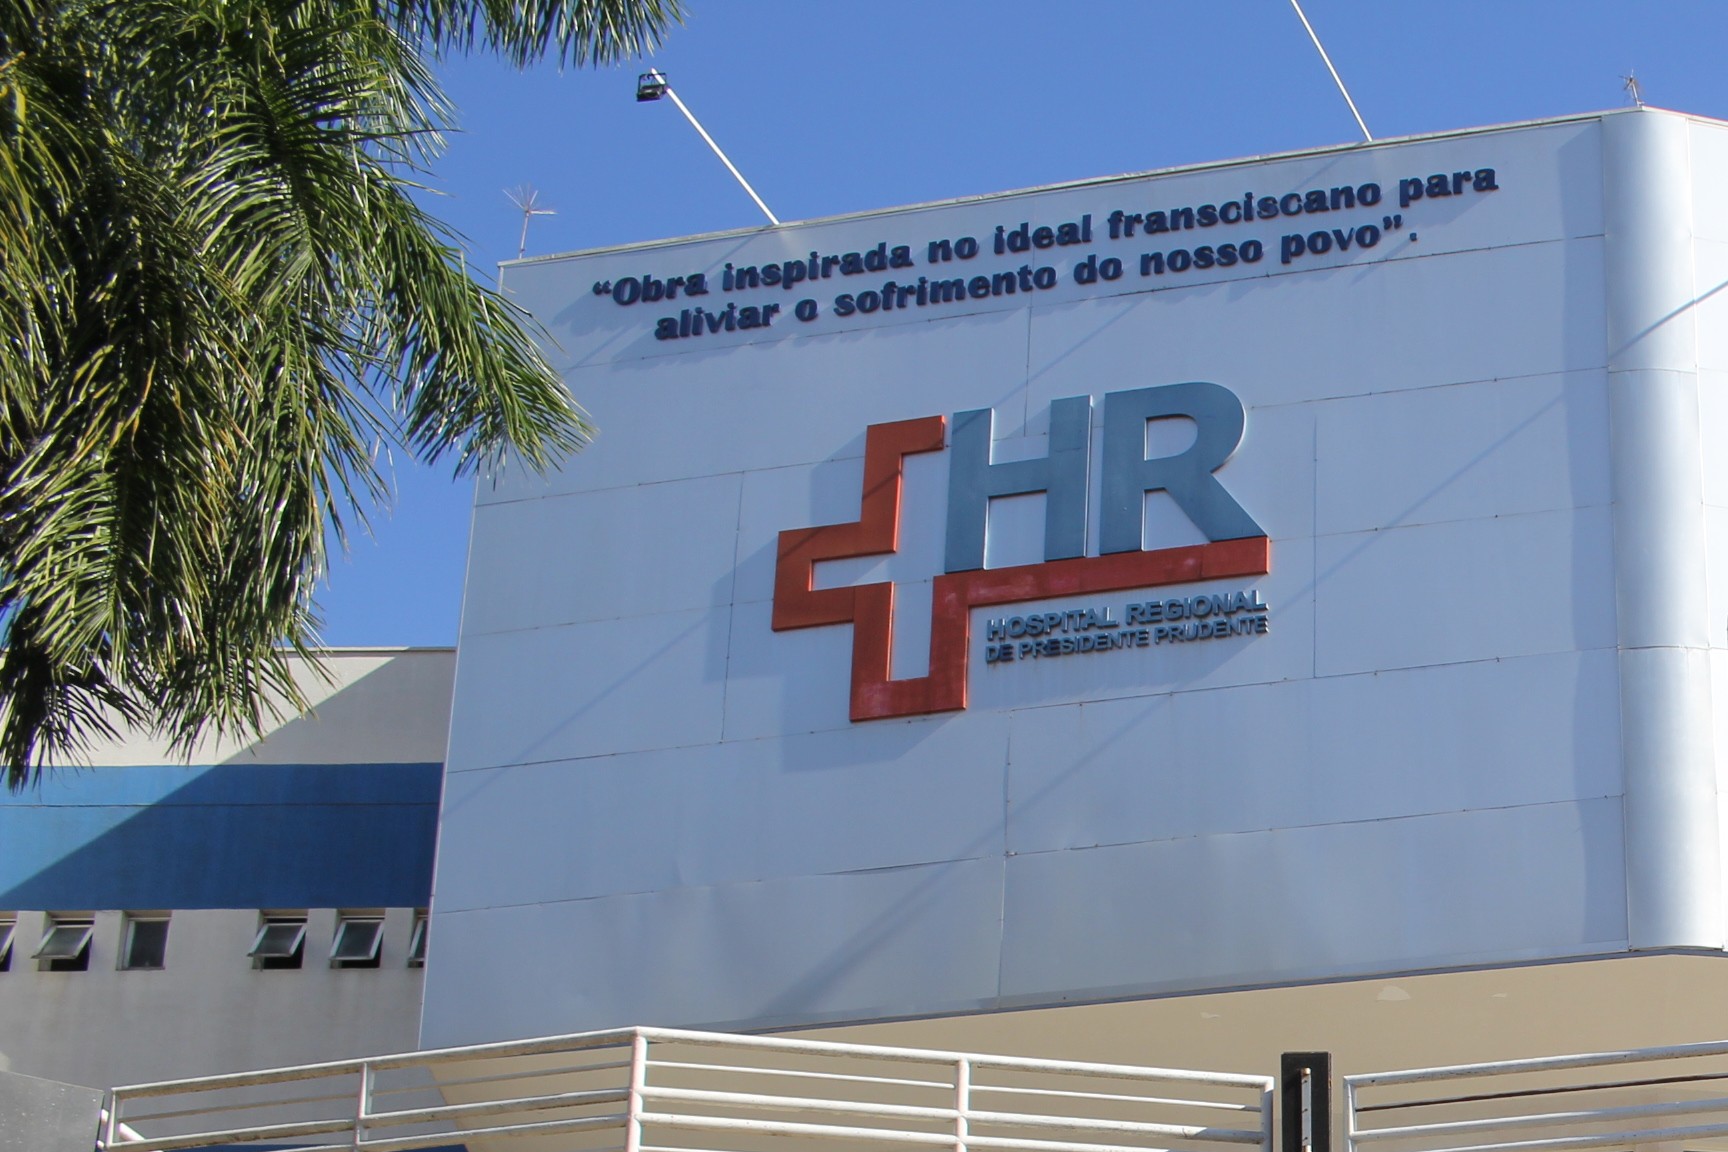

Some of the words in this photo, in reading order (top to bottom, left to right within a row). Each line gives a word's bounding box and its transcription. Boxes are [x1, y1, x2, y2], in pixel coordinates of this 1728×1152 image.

[722, 242, 914, 291] inspirada
[928, 235, 979, 263] no
[994, 213, 1092, 254] ideal
[1107, 180, 1382, 239] fransciscano
[1399, 166, 1499, 207] para
[654, 301, 781, 341] aliviar
[795, 297, 819, 322] o
[833, 263, 1057, 317] sofrimento
[1073, 253, 1123, 285] do
[1139, 236, 1264, 277] nosso
[944, 381, 1268, 574] HR
[985, 642, 1015, 664] DE
[1018, 627, 1150, 661] PRESIDENTE
[1154, 614, 1270, 645] PRUDENTE
[986, 605, 1119, 642] HOSPITAL
[1125, 590, 1269, 626] REGIONAL
